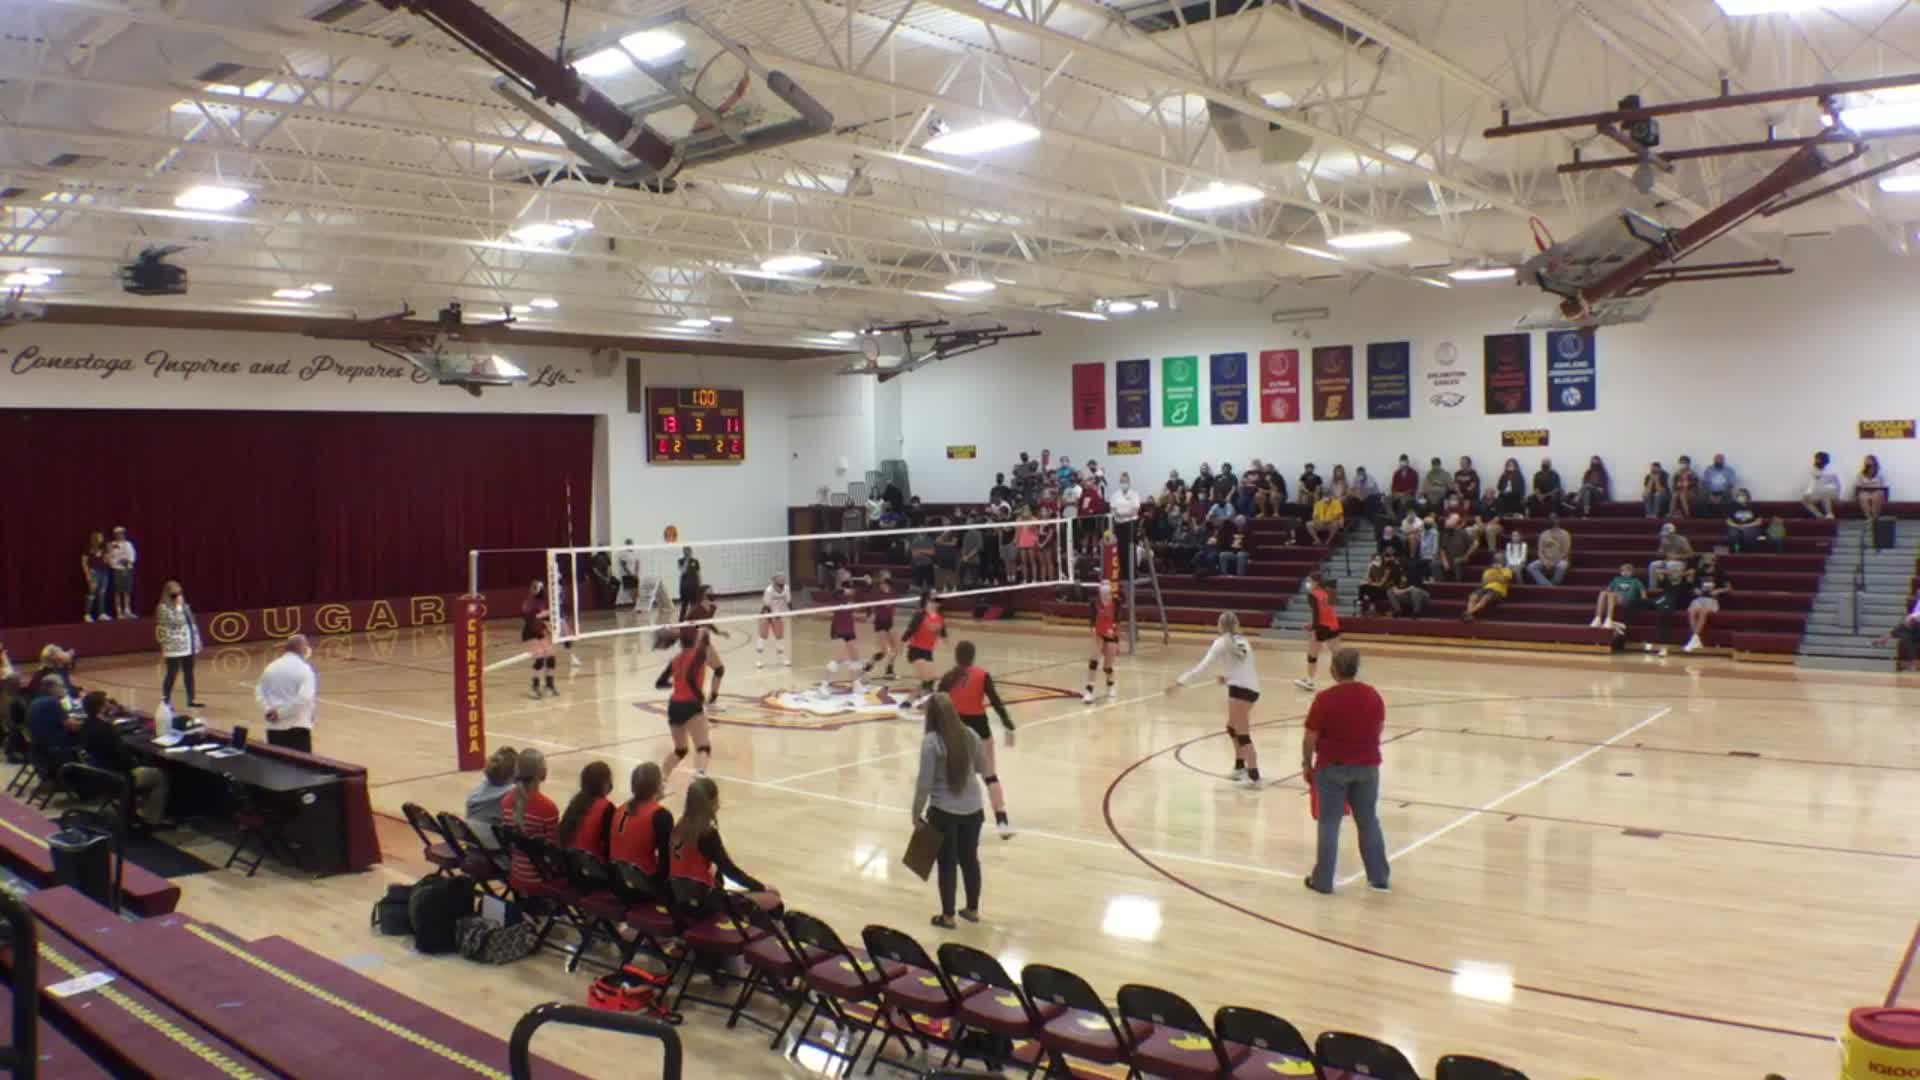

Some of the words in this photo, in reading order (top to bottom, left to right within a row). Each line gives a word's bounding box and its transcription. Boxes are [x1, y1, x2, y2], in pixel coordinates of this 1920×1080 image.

[144, 349, 240, 381] Inspires
[249, 359, 290, 375] and
[299, 354, 405, 384] Prepares
[695, 419, 703, 432] 3
[466, 617, 481, 754] CONESTOGA
